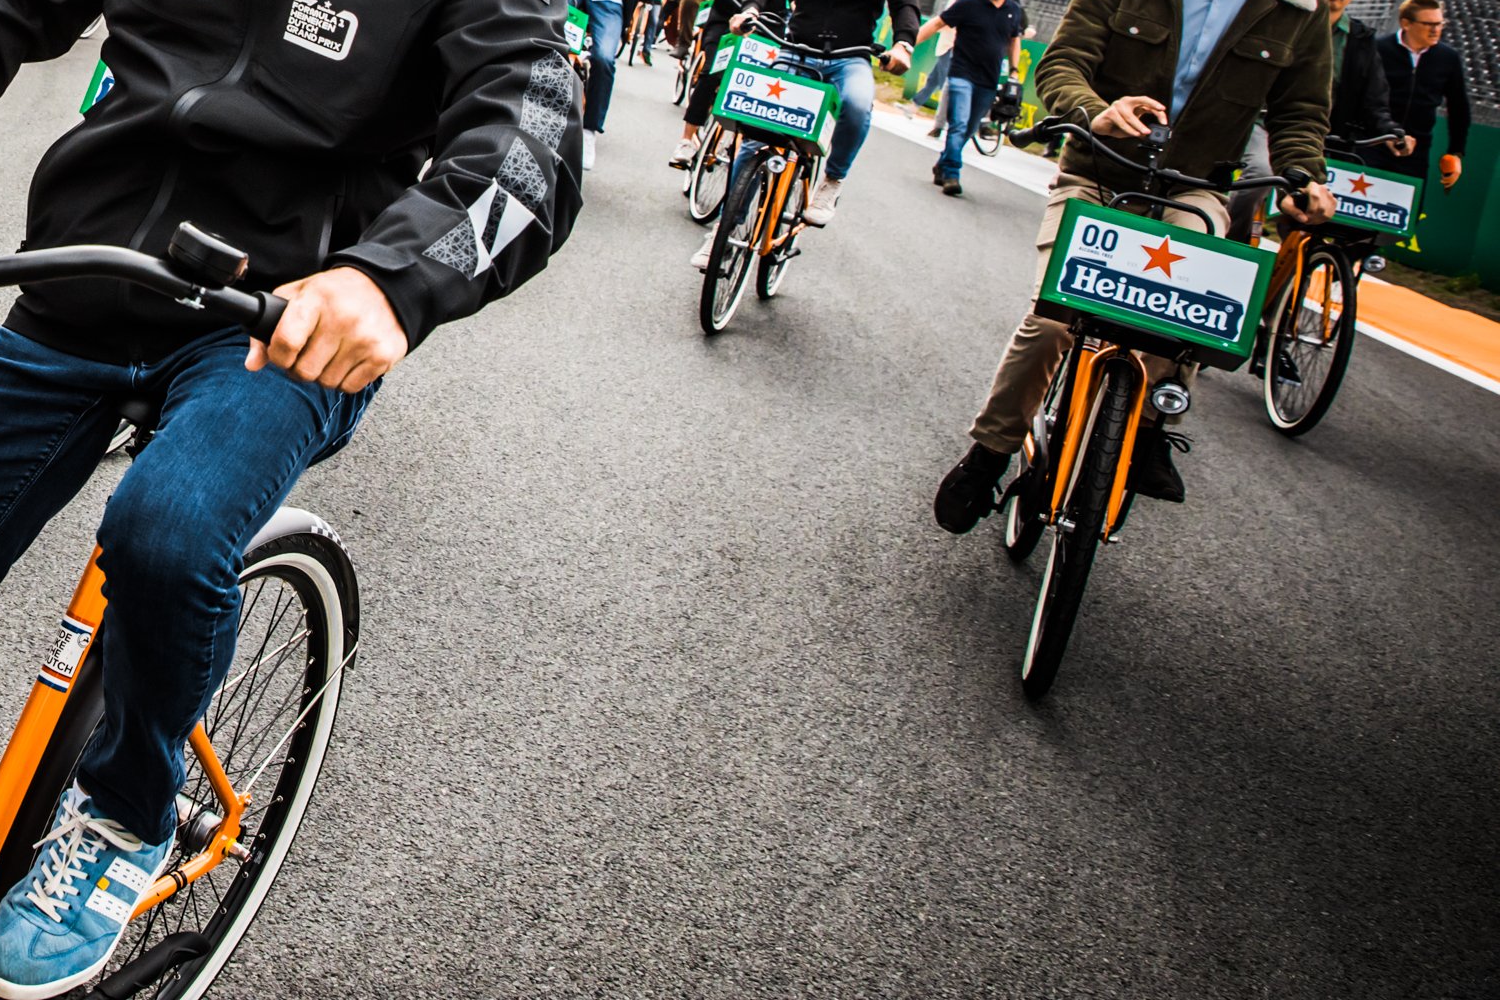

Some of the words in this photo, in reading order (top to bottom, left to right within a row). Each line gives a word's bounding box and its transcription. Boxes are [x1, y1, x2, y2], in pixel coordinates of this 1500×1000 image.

[287, 16, 319, 35] DUTCH
[290, 8, 337, 33] HEINEKEN
[291, 1, 338, 25] FORMULA
[338, 18, 345, 28] 1
[286, 24, 318, 42] GRAND
[317, 36, 342, 51] PRIX
[1336, 199, 1400, 225] ineken
[1081, 224, 1119, 252] 0.0
[45, 657, 74, 675] UTCH
